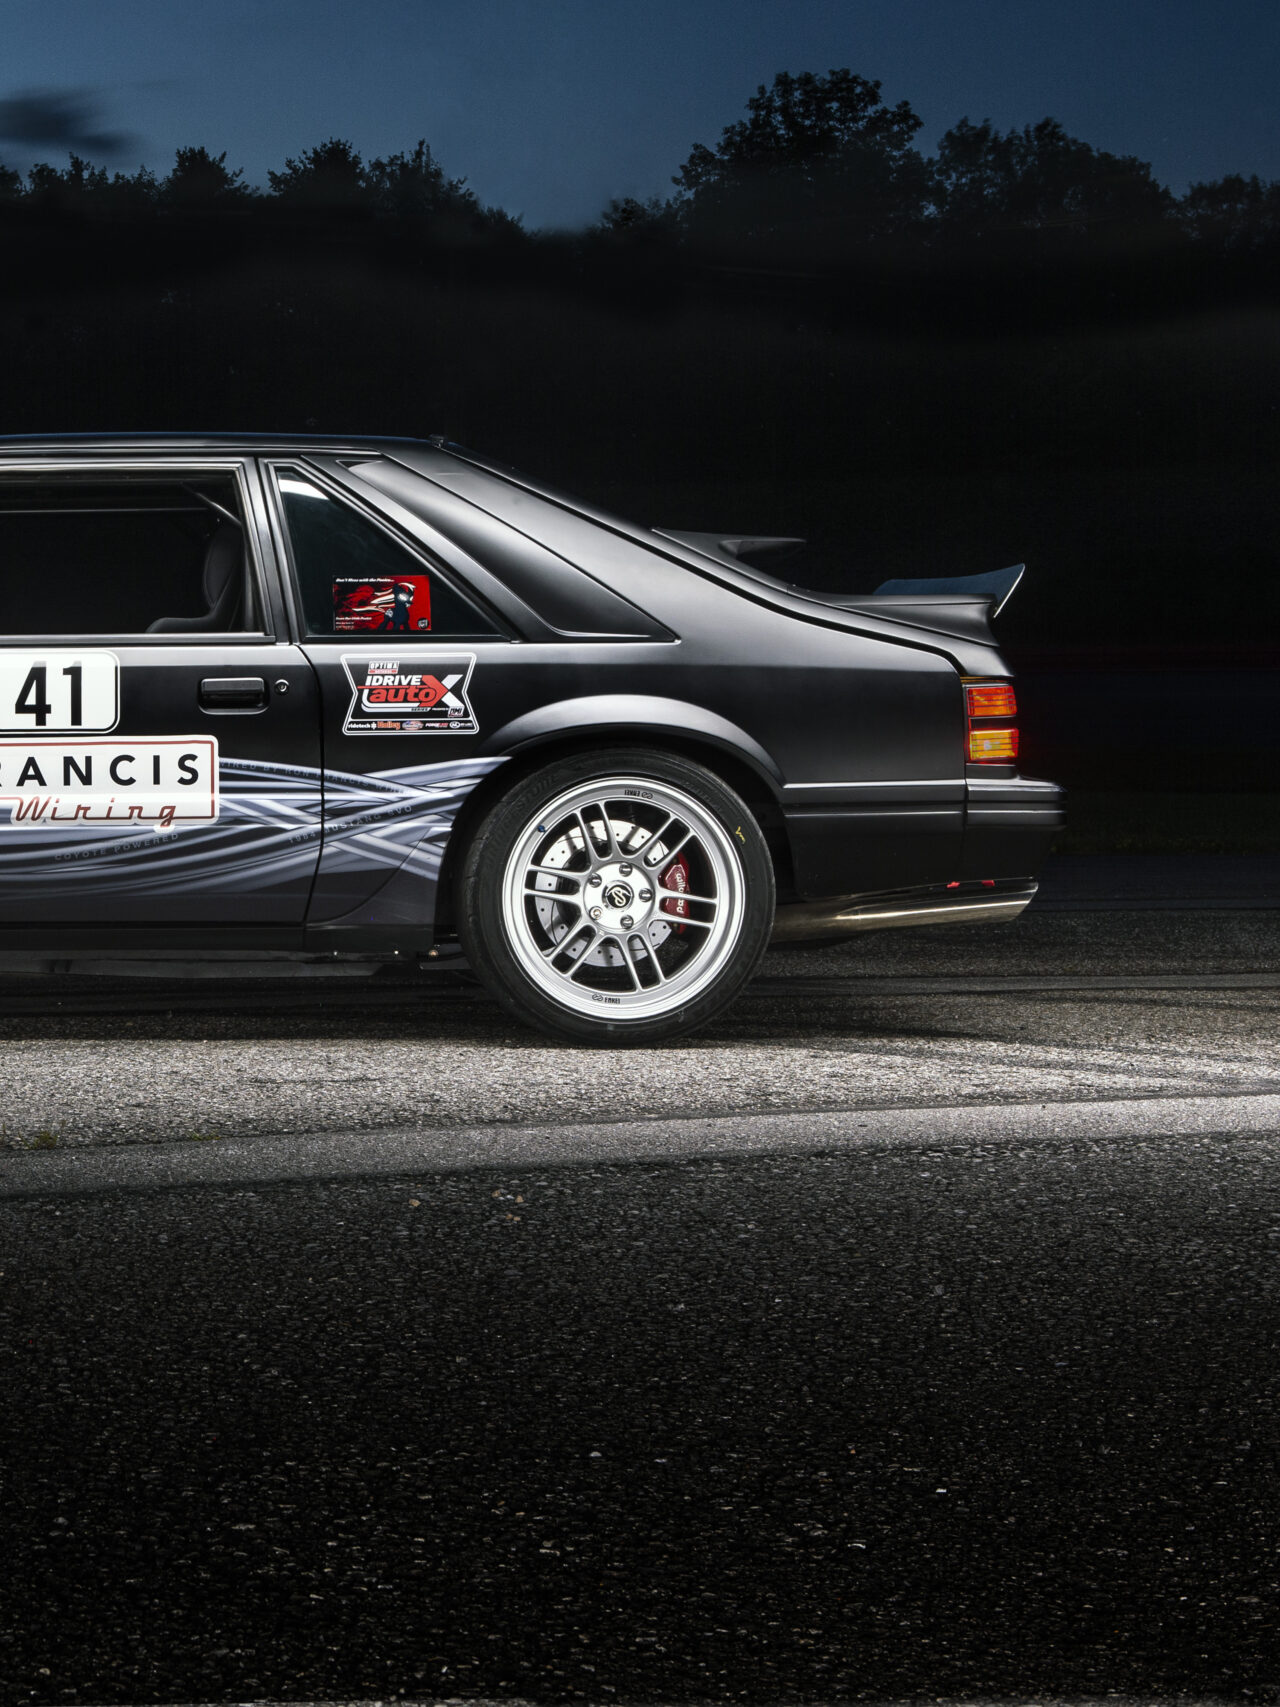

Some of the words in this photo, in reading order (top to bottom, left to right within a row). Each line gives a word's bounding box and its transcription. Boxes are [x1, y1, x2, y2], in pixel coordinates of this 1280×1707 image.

[14, 660, 83, 727] 41
[377, 721, 401, 730] Holley
[263, 764, 277, 773] BY
[14, 795, 178, 828] Wiring
[386, 804, 412, 817] SVO
[54, 847, 107, 861] COYOTE
[113, 833, 179, 855] POWERED
[675, 873, 686, 914] wilod
